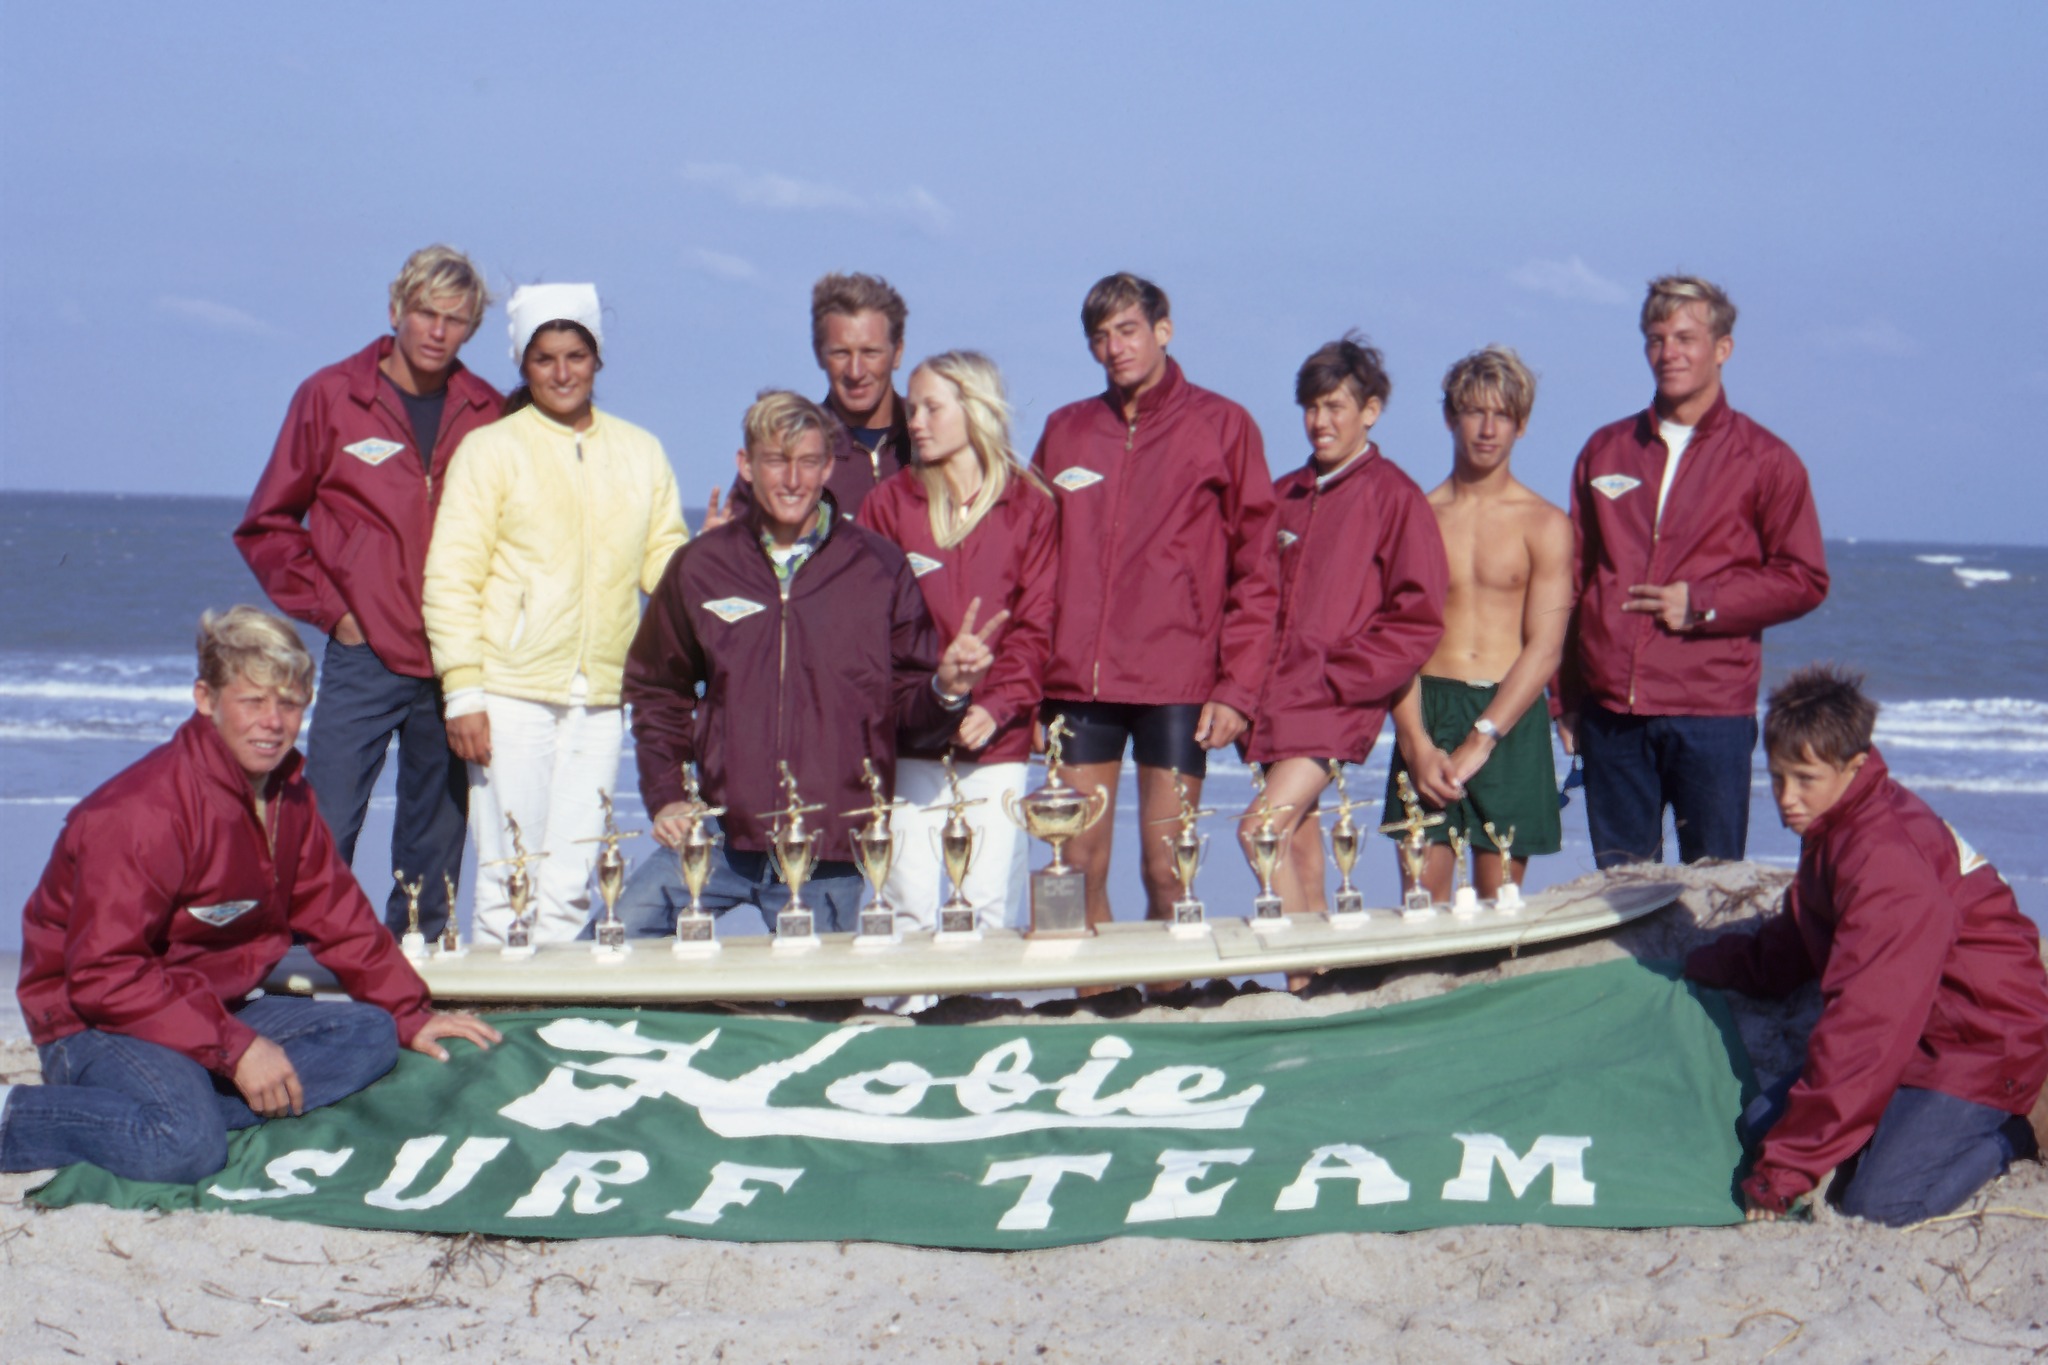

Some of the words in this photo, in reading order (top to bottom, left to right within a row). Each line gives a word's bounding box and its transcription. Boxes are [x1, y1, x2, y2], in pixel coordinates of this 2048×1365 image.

[499, 1017, 1266, 1147] Hobie
[207, 1134, 805, 1225] SURF
[980, 1132, 1597, 1231] TEAM
